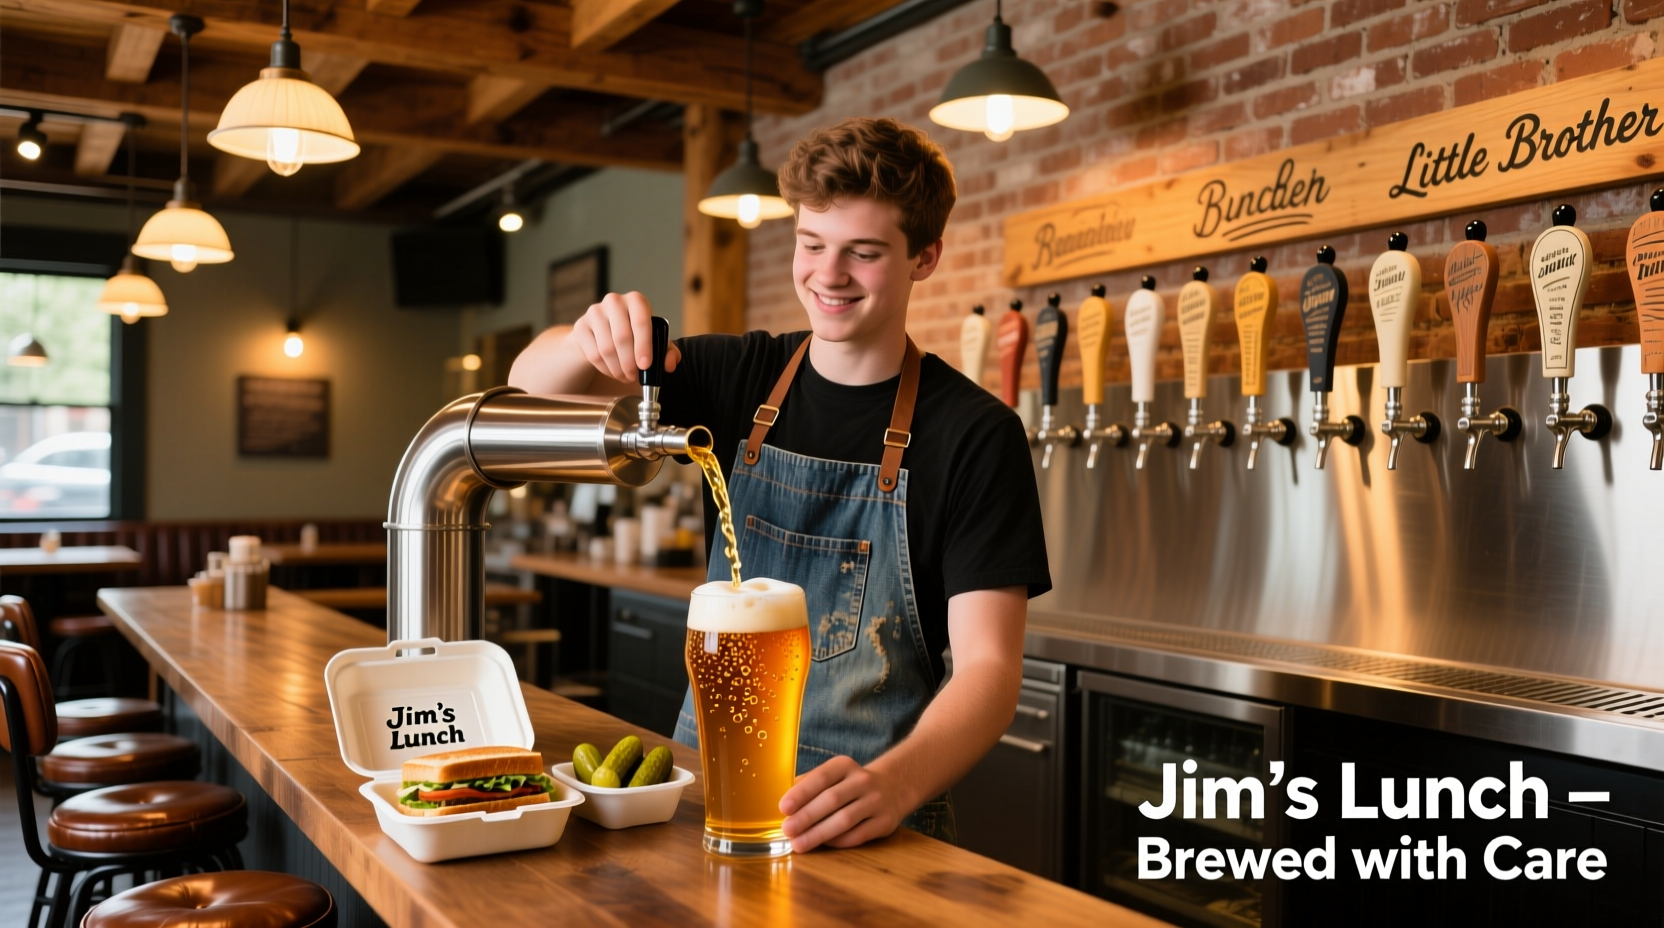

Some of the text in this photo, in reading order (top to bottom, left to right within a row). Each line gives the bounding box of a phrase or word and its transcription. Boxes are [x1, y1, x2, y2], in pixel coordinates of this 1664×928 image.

[1389, 97, 1664, 199] Little Brother
[386, 702, 456, 729] Jim’s
[390, 725, 465, 750] Lunch
